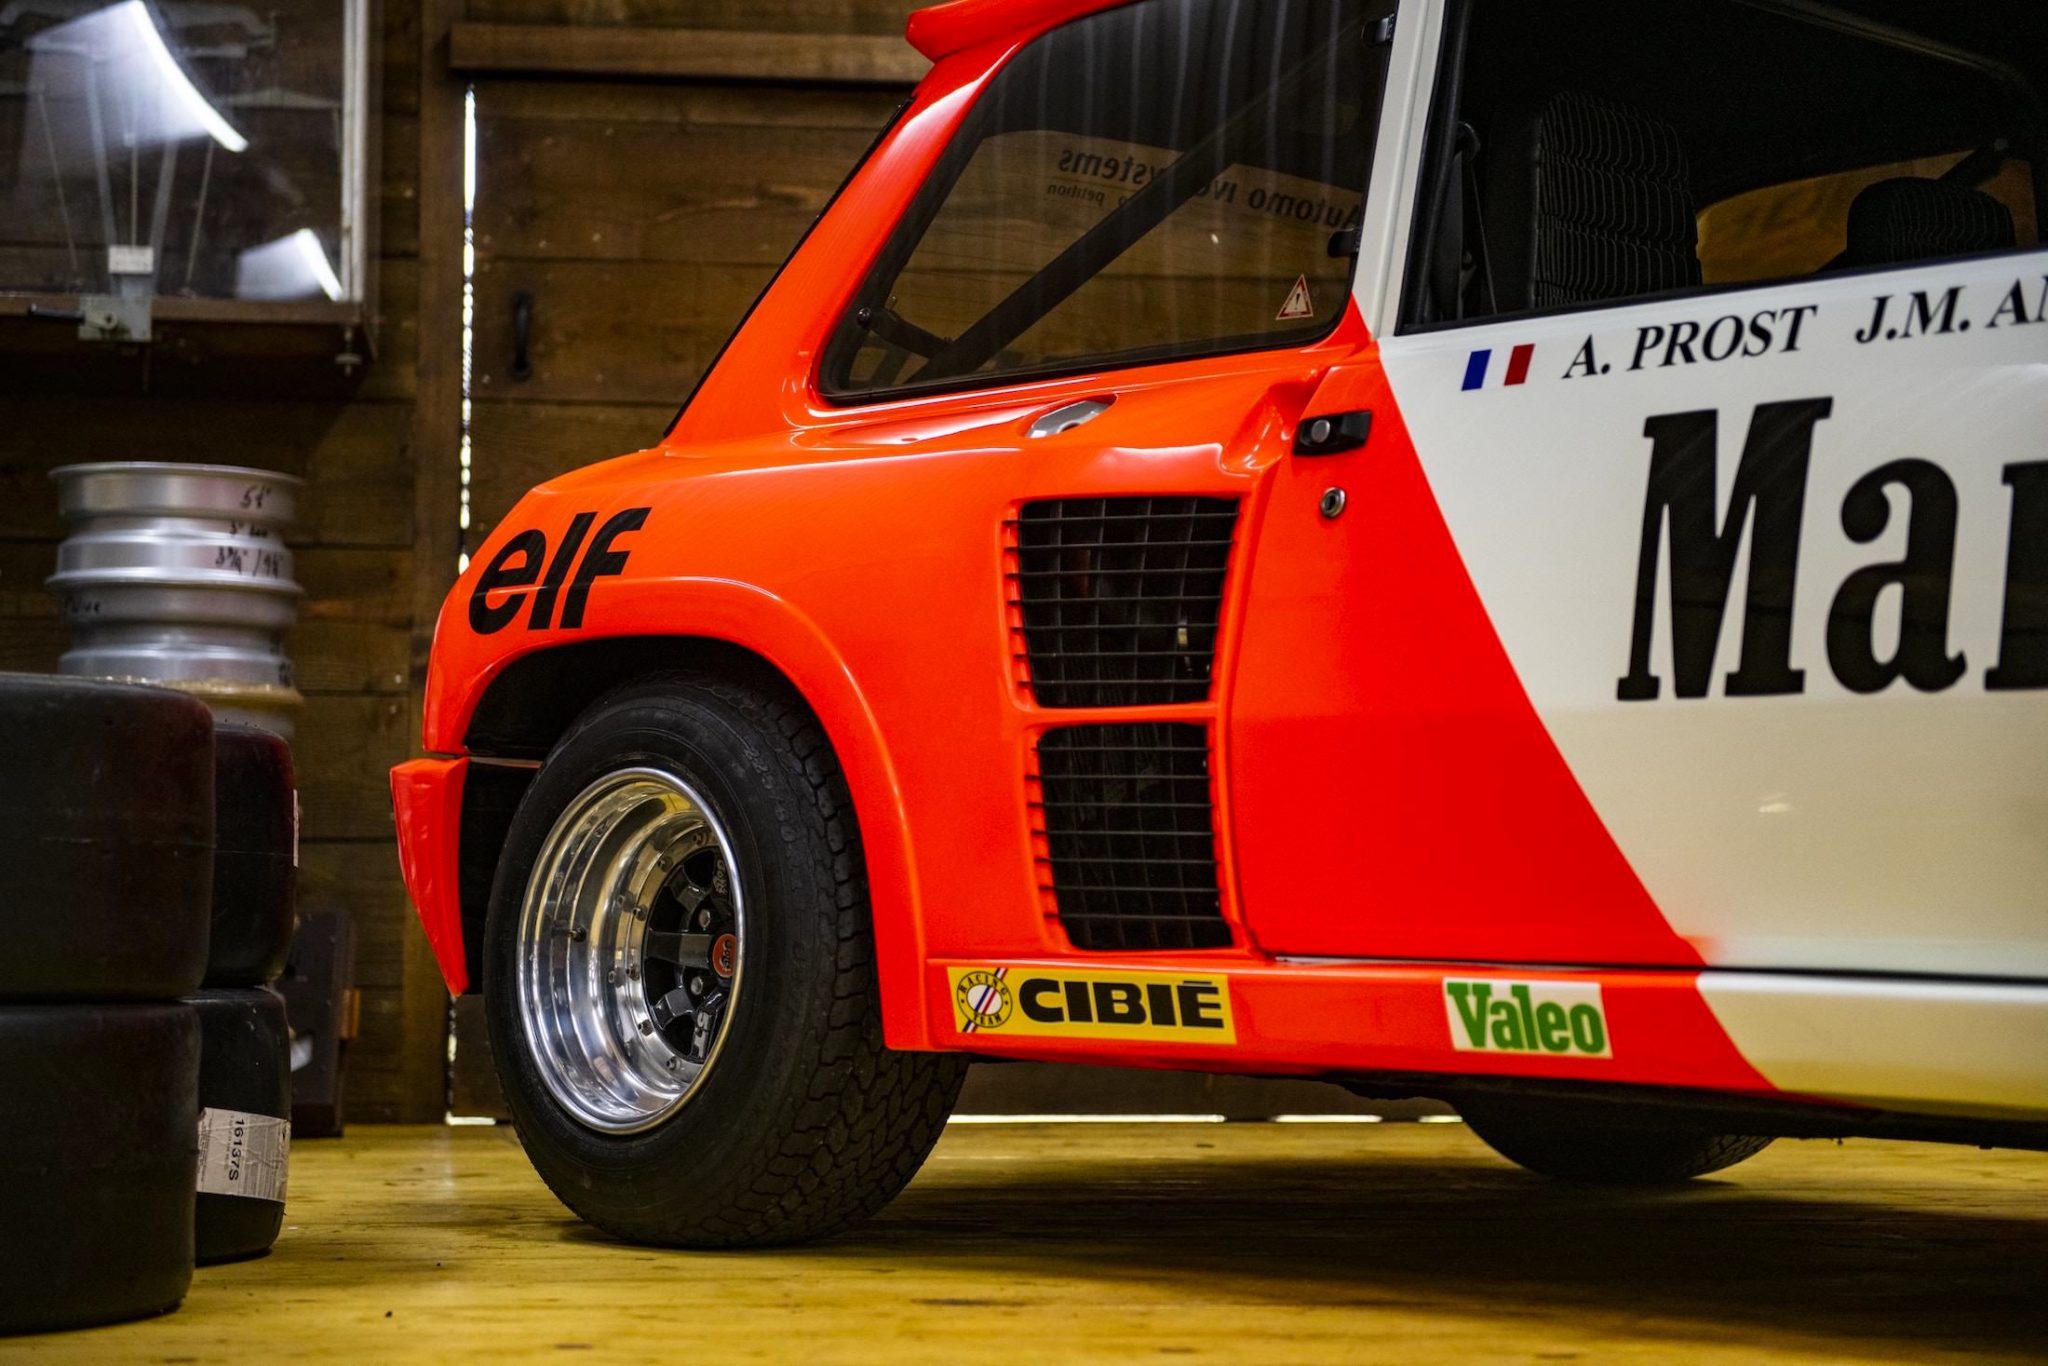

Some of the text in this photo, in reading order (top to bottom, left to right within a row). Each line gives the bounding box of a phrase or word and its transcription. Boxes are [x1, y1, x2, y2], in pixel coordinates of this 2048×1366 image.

[1562, 305, 1818, 379] A. PROST
[1855, 286, 1971, 344] J.M.
[469, 507, 653, 635] elf
[958, 974, 1009, 995] RACING
[1447, 977, 1606, 1054] Valeo
[973, 1012, 1003, 1025] TEAM
